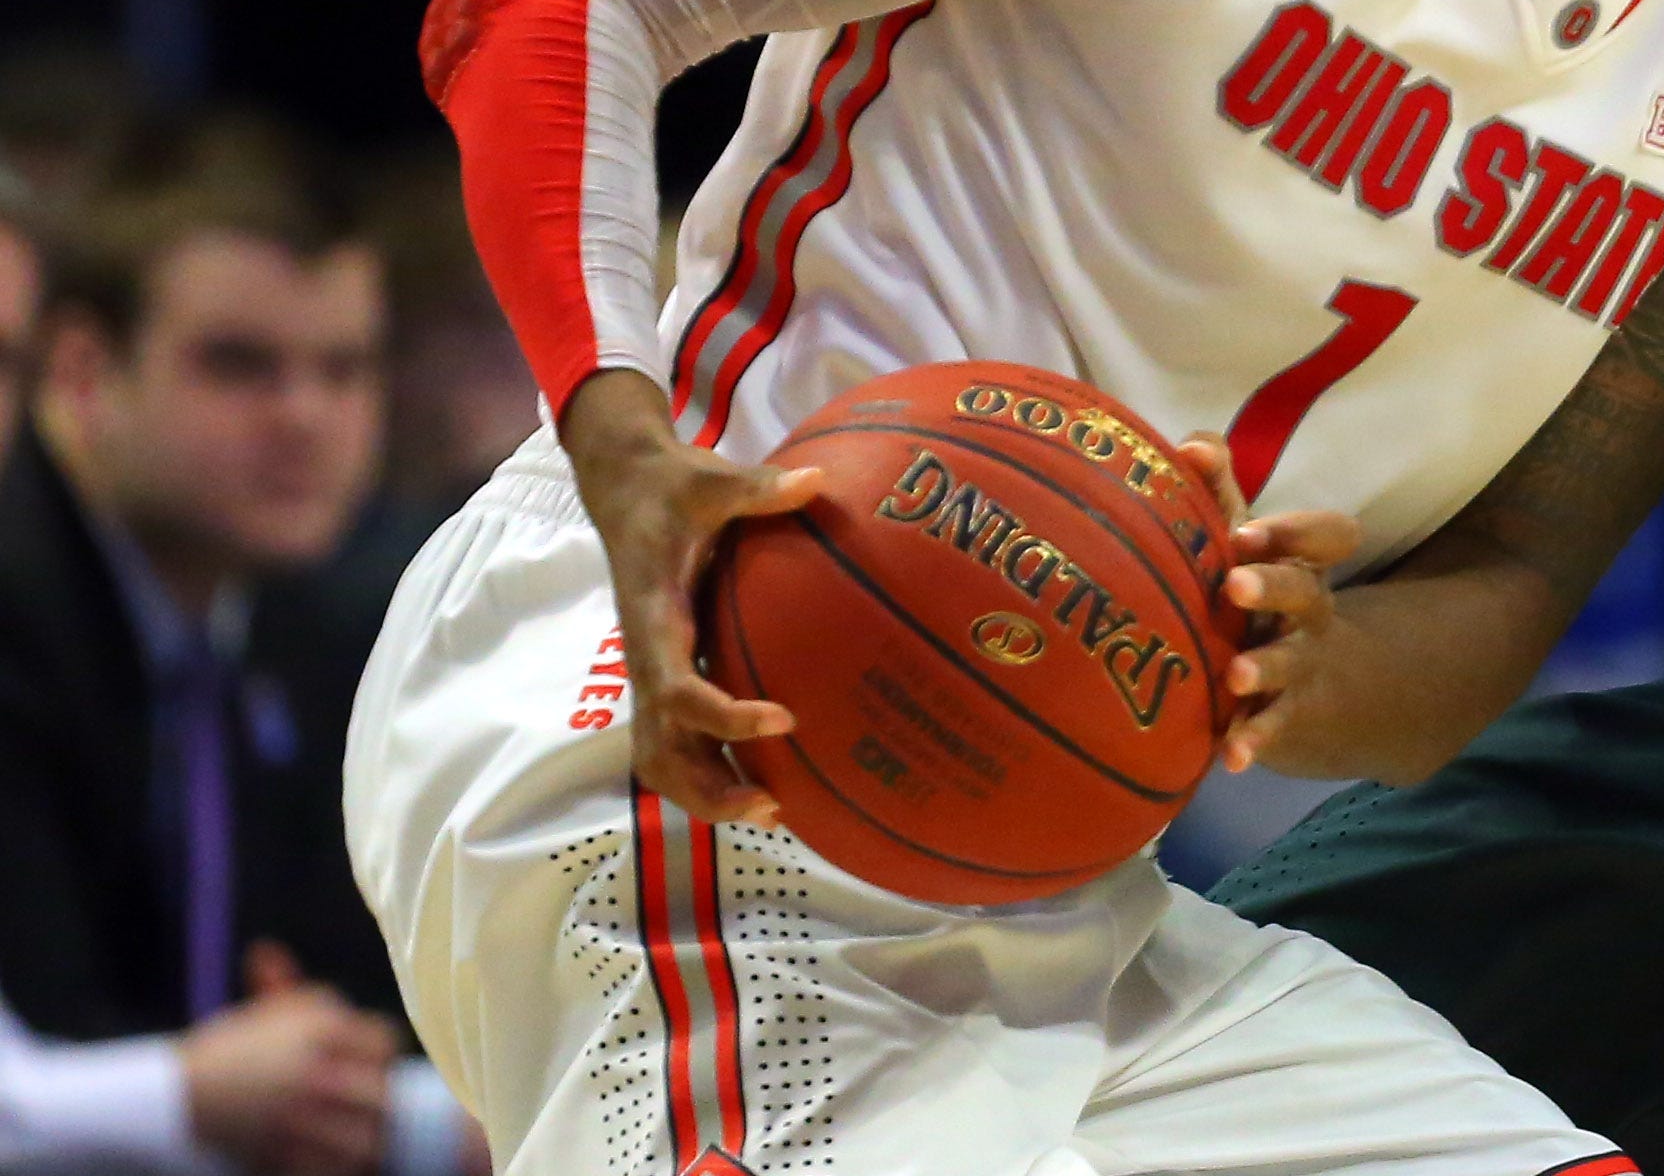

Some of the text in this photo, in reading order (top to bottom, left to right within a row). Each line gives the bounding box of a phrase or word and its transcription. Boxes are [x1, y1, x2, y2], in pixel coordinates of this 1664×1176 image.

[1226, 276, 1420, 505] 1
[567, 625, 630, 730] EYES
[875, 449, 1191, 730] SPALDING
